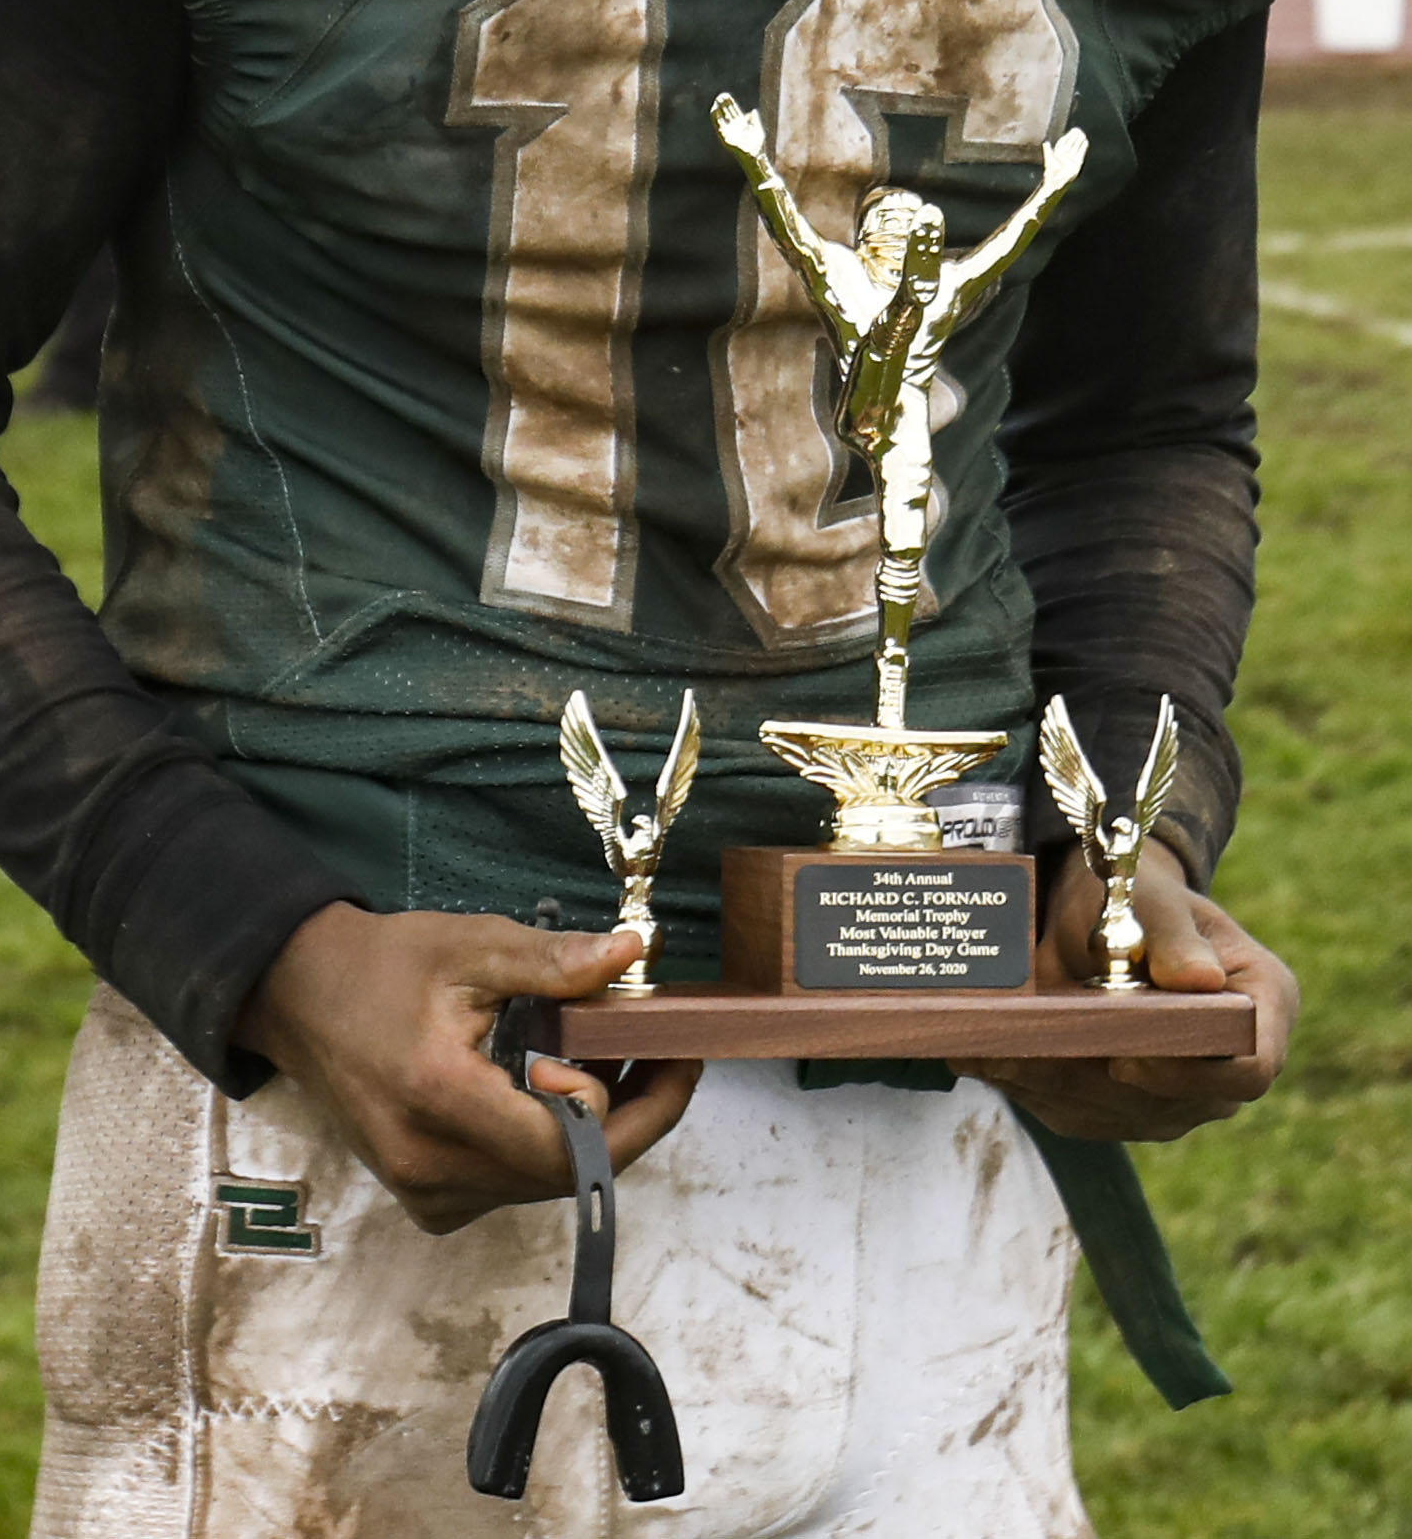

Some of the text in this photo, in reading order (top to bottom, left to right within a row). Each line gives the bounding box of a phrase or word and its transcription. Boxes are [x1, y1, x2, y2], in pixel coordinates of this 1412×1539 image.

[873, 871, 954, 886] 34th Annual
[819, 891, 1008, 906] RICHARD C. FORNARO
[855, 908, 972, 926] Memorial Trophy
[839, 925, 988, 943] Most Valuable Player
[825, 942, 1001, 960] Thanksgiving Day Game
[858, 962, 969, 978] November 26, 2020
